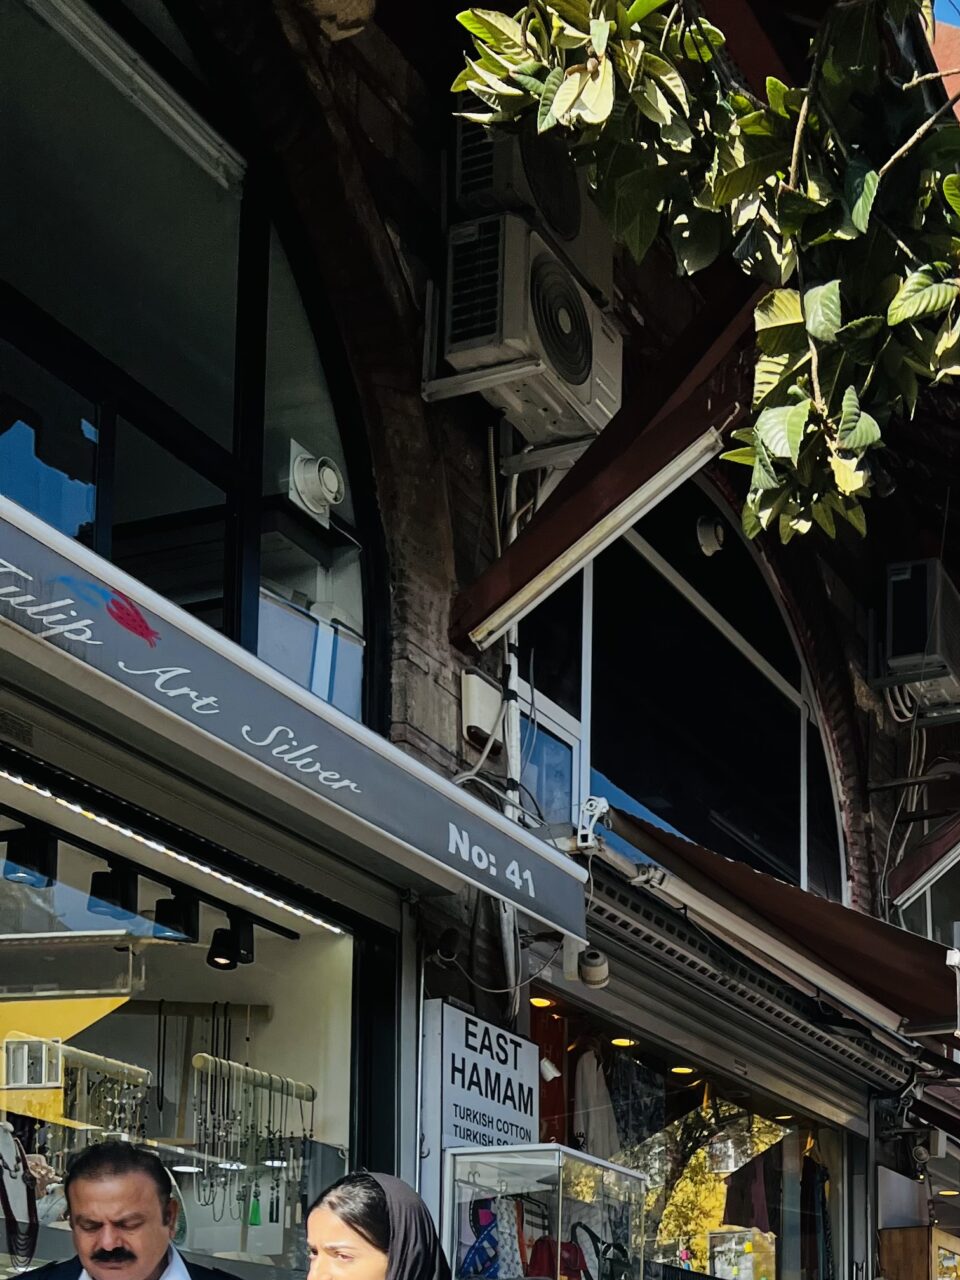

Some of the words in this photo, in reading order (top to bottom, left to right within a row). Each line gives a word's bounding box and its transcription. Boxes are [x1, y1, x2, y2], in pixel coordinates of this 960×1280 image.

[118, 661, 220, 714] Art
[241, 725, 363, 793] Silver
[448, 822, 497, 876] No:
[505, 860, 535, 898] 41
[465, 1016, 522, 1071] EAST
[451, 1052, 534, 1117] HAMAM
[453, 1103, 494, 1130] TURKISH
[496, 1118, 532, 1142] COTTON
[453, 1124, 494, 1147] TURKISH
